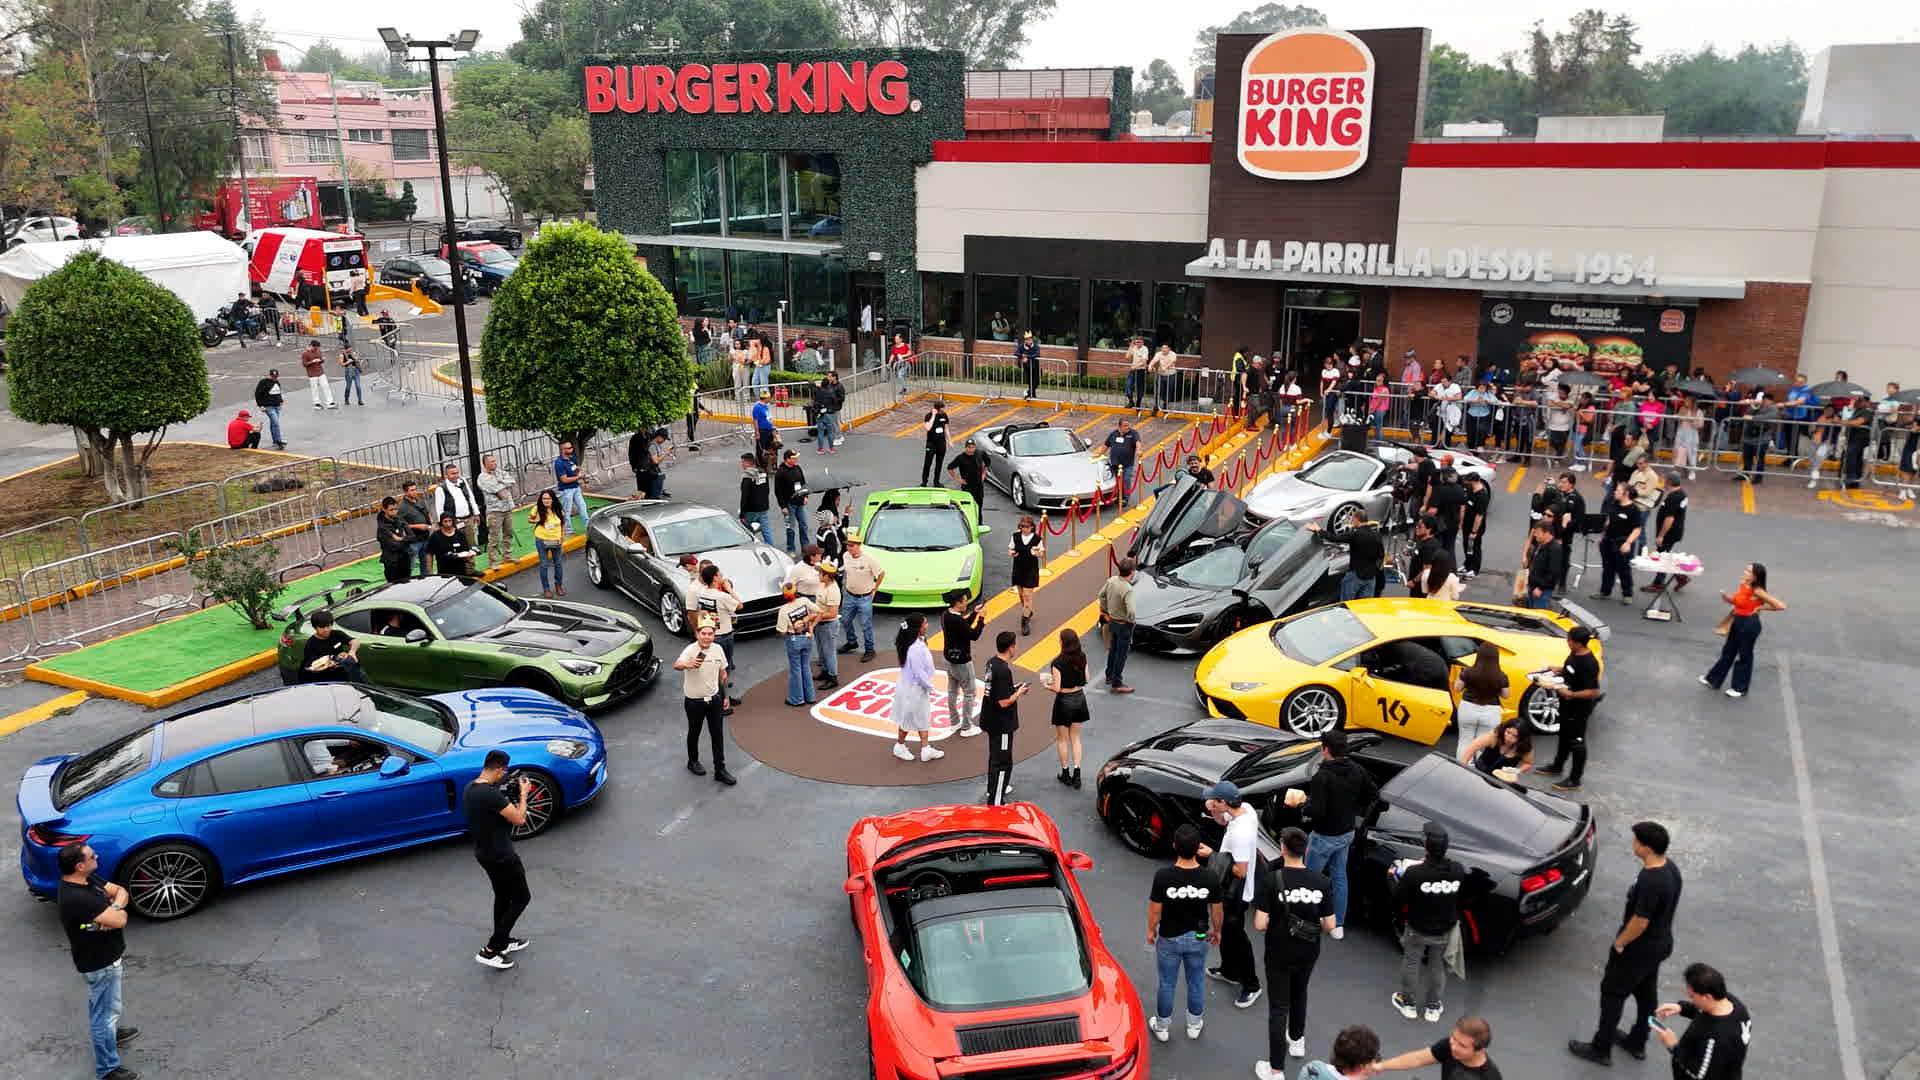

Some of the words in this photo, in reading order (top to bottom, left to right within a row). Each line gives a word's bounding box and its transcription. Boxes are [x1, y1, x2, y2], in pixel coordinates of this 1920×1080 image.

[584, 63, 773, 114] BURGER
[776, 60, 910, 115] KING
[1247, 78, 1365, 105] BURGER
[1245, 107, 1362, 147] KING
[1208, 238, 1226, 269] A
[1237, 239, 1272, 271] LA
[1283, 241, 1433, 278] PARRILLA
[1446, 248, 1553, 283] DESDE
[1575, 251, 1657, 287] 1954
[828, 691, 952, 728] KIG
